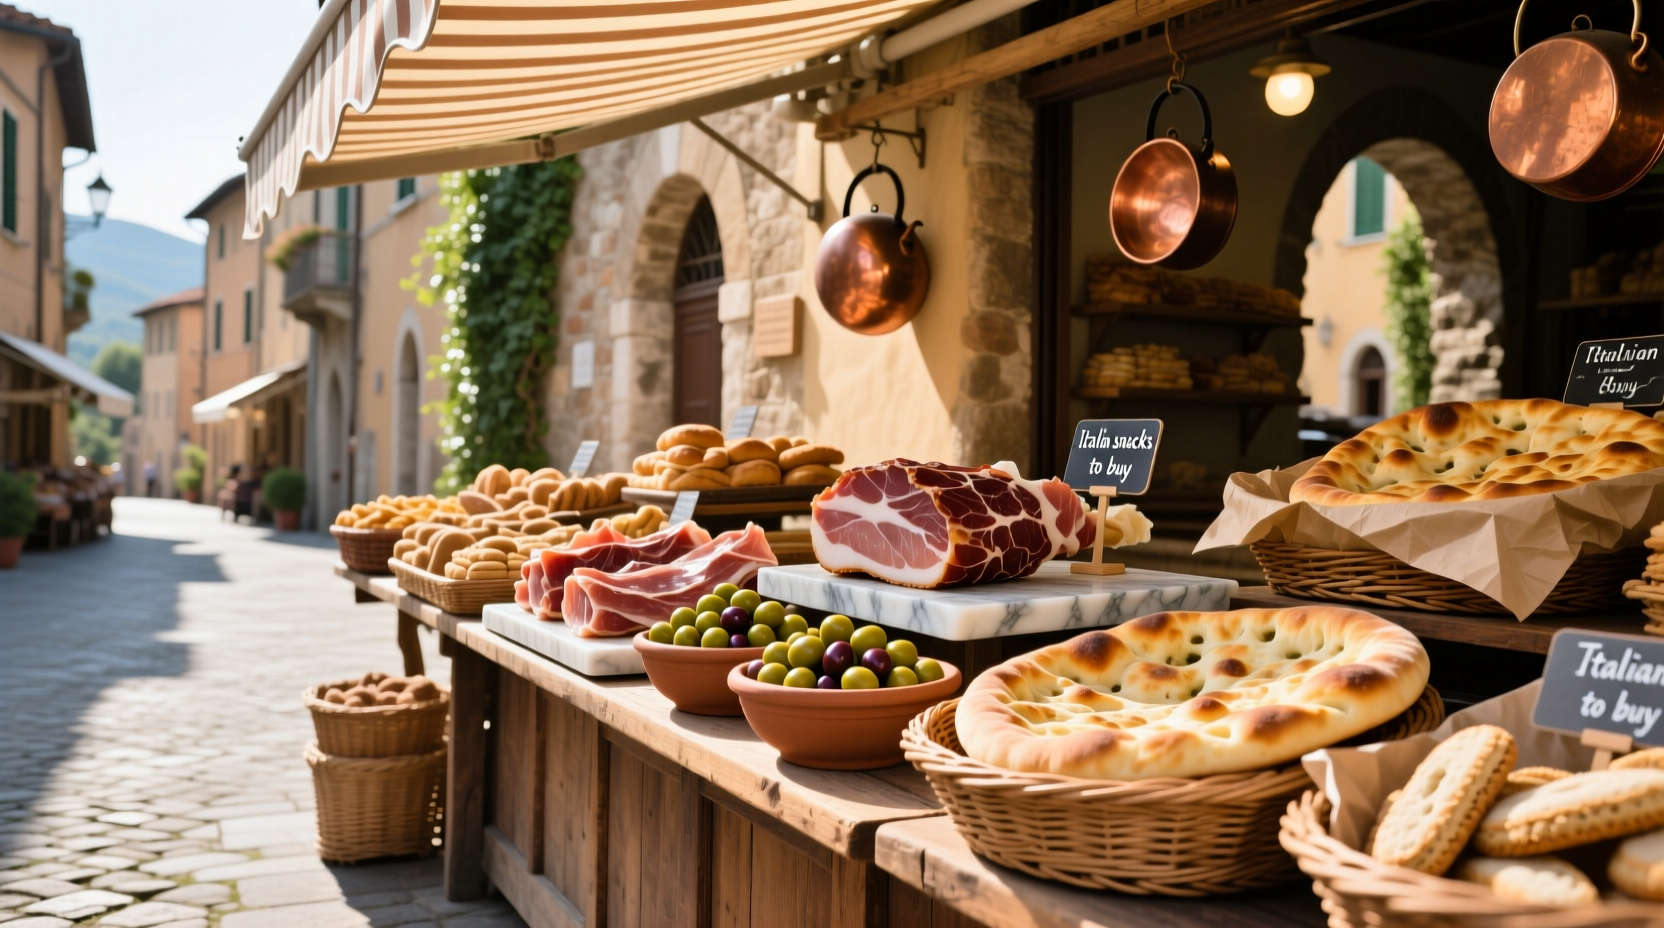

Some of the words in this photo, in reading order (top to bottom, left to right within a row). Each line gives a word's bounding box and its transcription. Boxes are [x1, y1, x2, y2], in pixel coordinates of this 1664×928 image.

[1089, 457, 1103, 475] to
[1106, 455, 1133, 484] buy
[1580, 690, 1607, 719] to
[1611, 689, 1663, 738] buy
